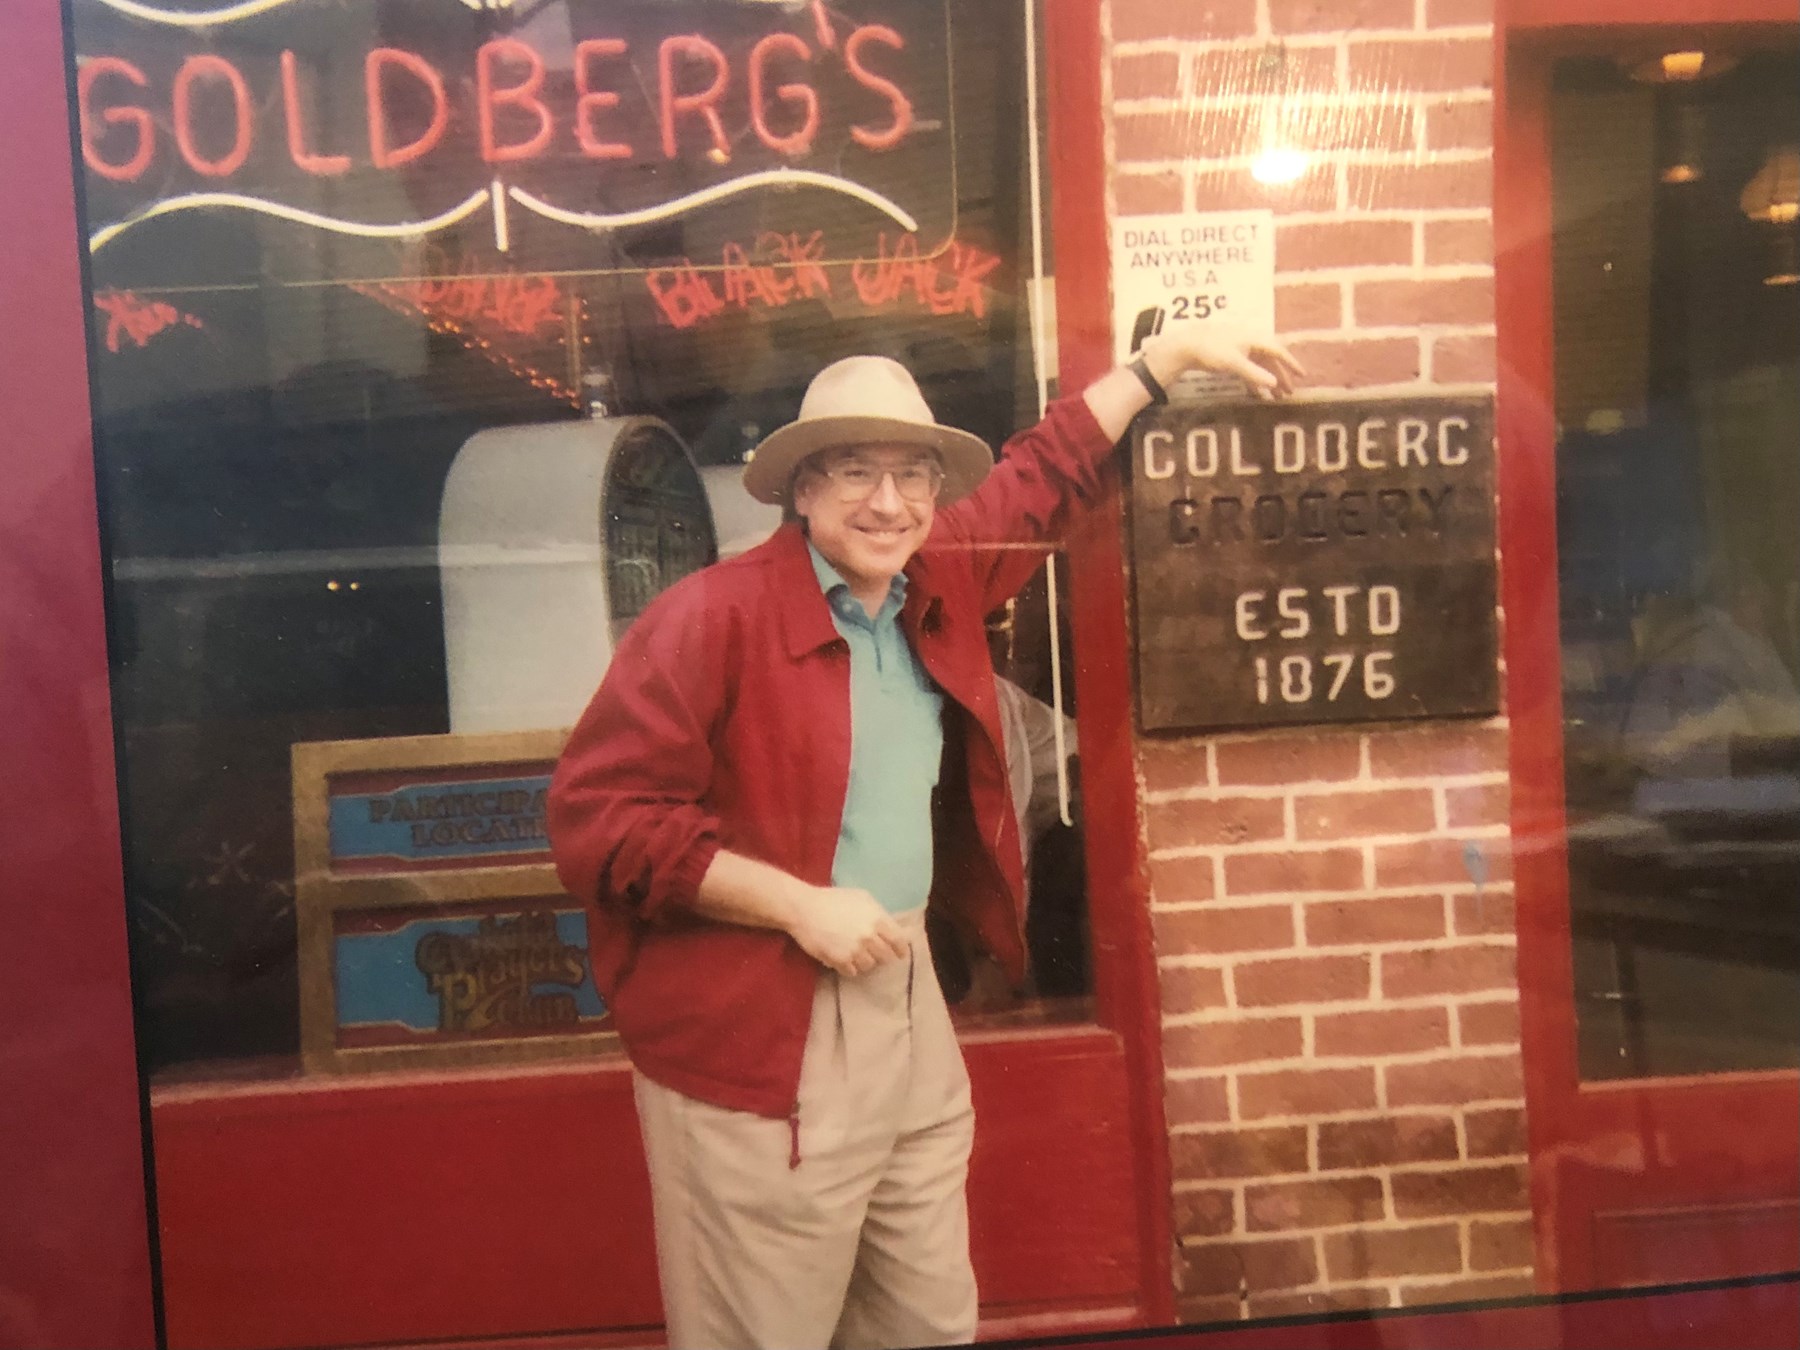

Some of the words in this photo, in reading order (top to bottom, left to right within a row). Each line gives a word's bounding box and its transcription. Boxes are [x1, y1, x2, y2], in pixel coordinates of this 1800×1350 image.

[77, 0, 914, 182] GOLDBERG'S
[1123, 229, 1171, 249] DIAL
[1180, 223, 1260, 246] DIRECT
[1130, 246, 1255, 269] ANYWHERE
[646, 229, 832, 328] BLACK
[851, 231, 1001, 320] JACK
[1143, 416, 1470, 480] GOLDBERG
[1169, 485, 1454, 547] GROCERY
[1234, 584, 1402, 641] ESTD
[1254, 651, 1396, 705] 1876
